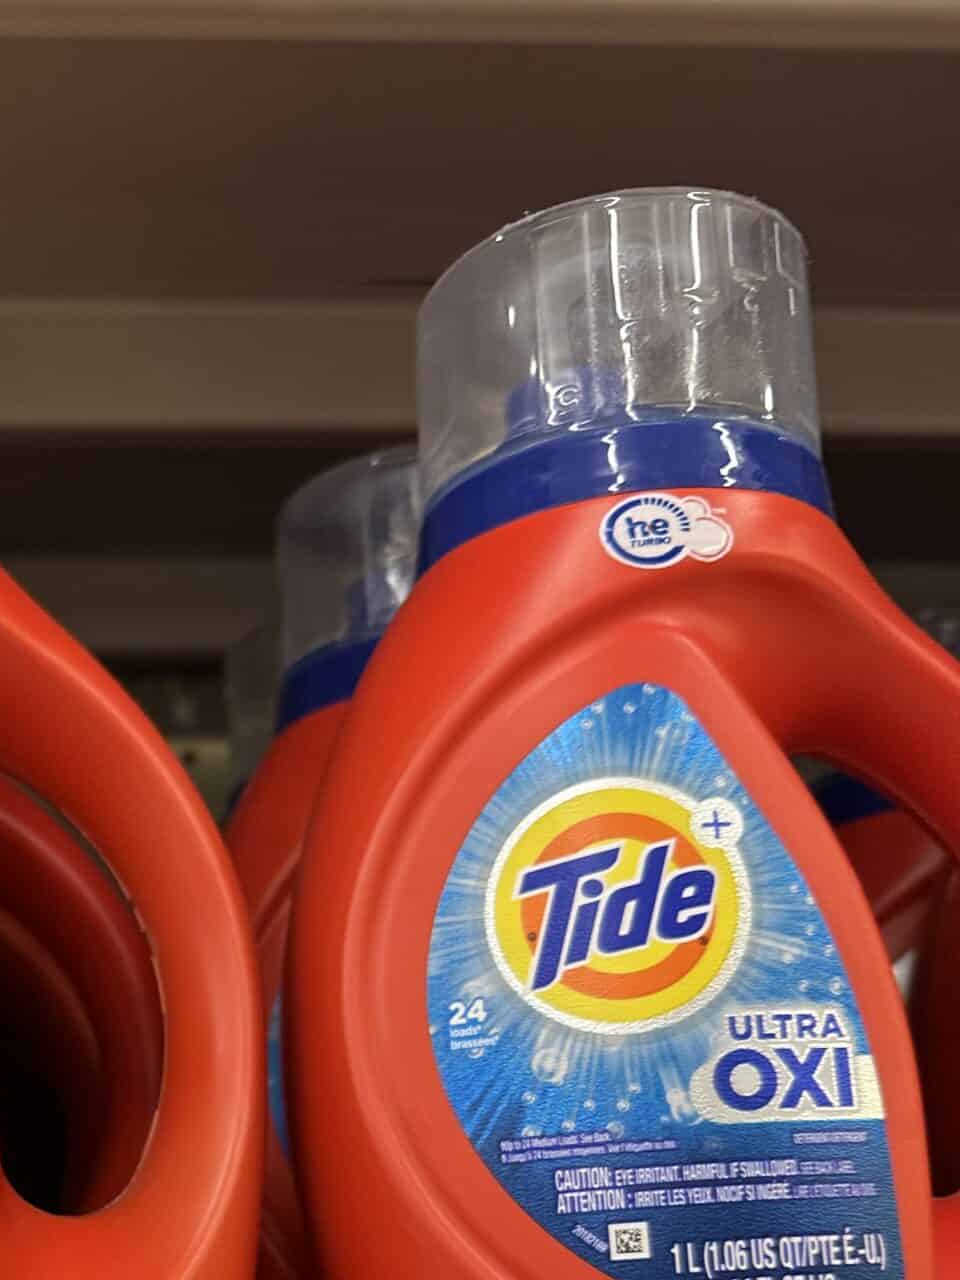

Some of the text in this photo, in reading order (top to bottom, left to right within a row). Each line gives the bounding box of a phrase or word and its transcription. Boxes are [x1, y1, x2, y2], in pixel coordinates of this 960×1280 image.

[519, 845, 715, 990] Tide
[449, 1000, 487, 1025] 24
[728, 1013, 844, 1041] ULTRA
[714, 1048, 853, 1111] OXI
[555, 1167, 613, 1191] CAUTION:
[615, 1169, 634, 1187] EYE
[557, 1188, 625, 1215] ATTENTION
[667, 1189, 687, 1207] LES
[670, 1243, 681, 1274] 1
[686, 1242, 701, 1273] L
[704, 1240, 747, 1279] (1.06
[751, 1238, 776, 1269] US
[780, 1235, 842, 1269] QT/PTE
